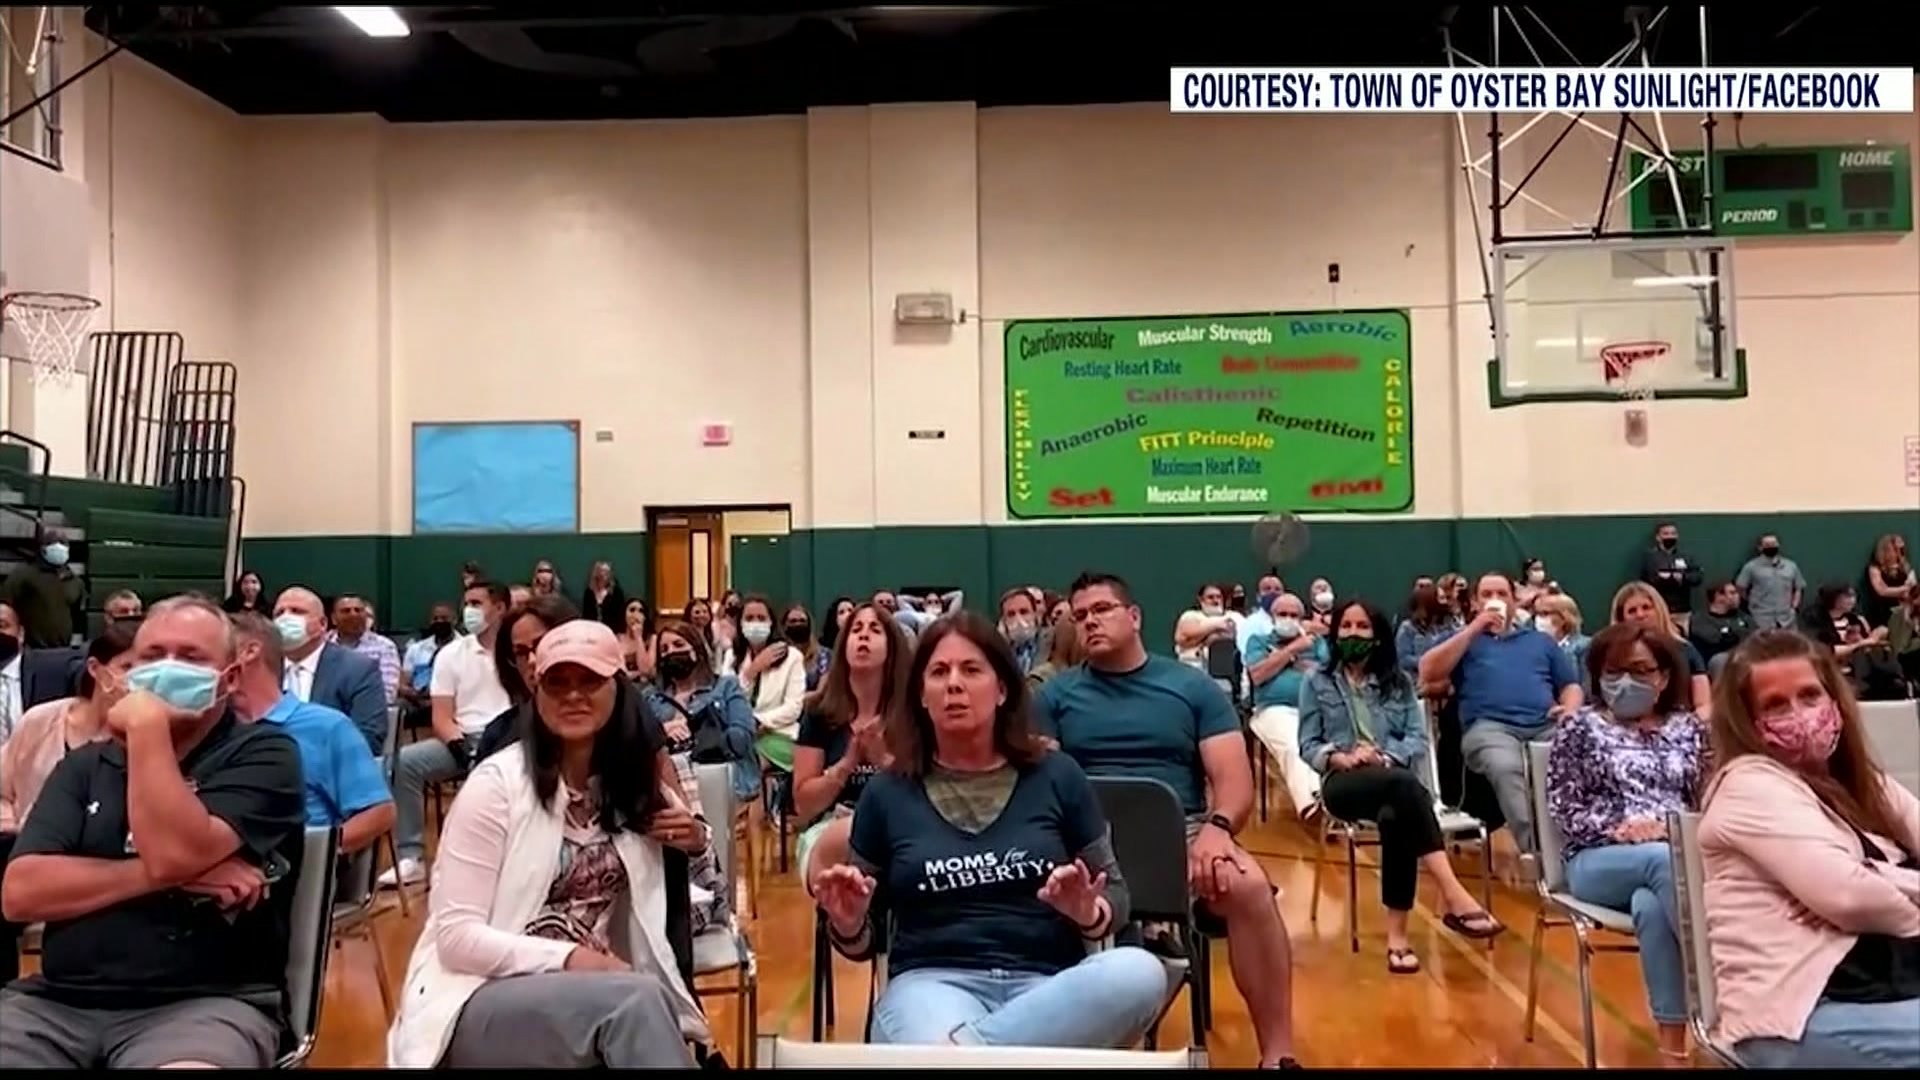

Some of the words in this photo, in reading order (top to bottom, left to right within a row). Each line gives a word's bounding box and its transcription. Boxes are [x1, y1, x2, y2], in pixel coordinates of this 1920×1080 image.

[1839, 151, 1896, 167] HOME
[1722, 208, 1778, 223] PERIOD
[1137, 325, 1205, 347] Muscular
[1209, 323, 1272, 345] Strength
[1289, 319, 1398, 342] Aerobic
[1019, 326, 1115, 360] Cardiovascular
[1064, 360, 1111, 379] Resting
[1115, 359, 1149, 375] Heart
[1153, 358, 1182, 375] Rate
[1126, 385, 1280, 404] Calisthenic
[1385, 358, 1404, 465] CALORIE
[1040, 413, 1149, 457] Anaerobic
[1256, 407, 1376, 442] Repetition
[1139, 431, 1182, 452] FITT
[1187, 429, 1275, 449] Principle
[1151, 456, 1203, 476] Maximum
[1206, 456, 1235, 475] Heart
[1237, 455, 1262, 475] Rate
[1049, 486, 1113, 508] Set
[1146, 485, 1202, 504] Muscular
[1205, 484, 1269, 503] Endurance
[925, 852, 998, 876] MOMS
[1002, 847, 1029, 867] for
[929, 858, 1045, 892] LIBERTY
